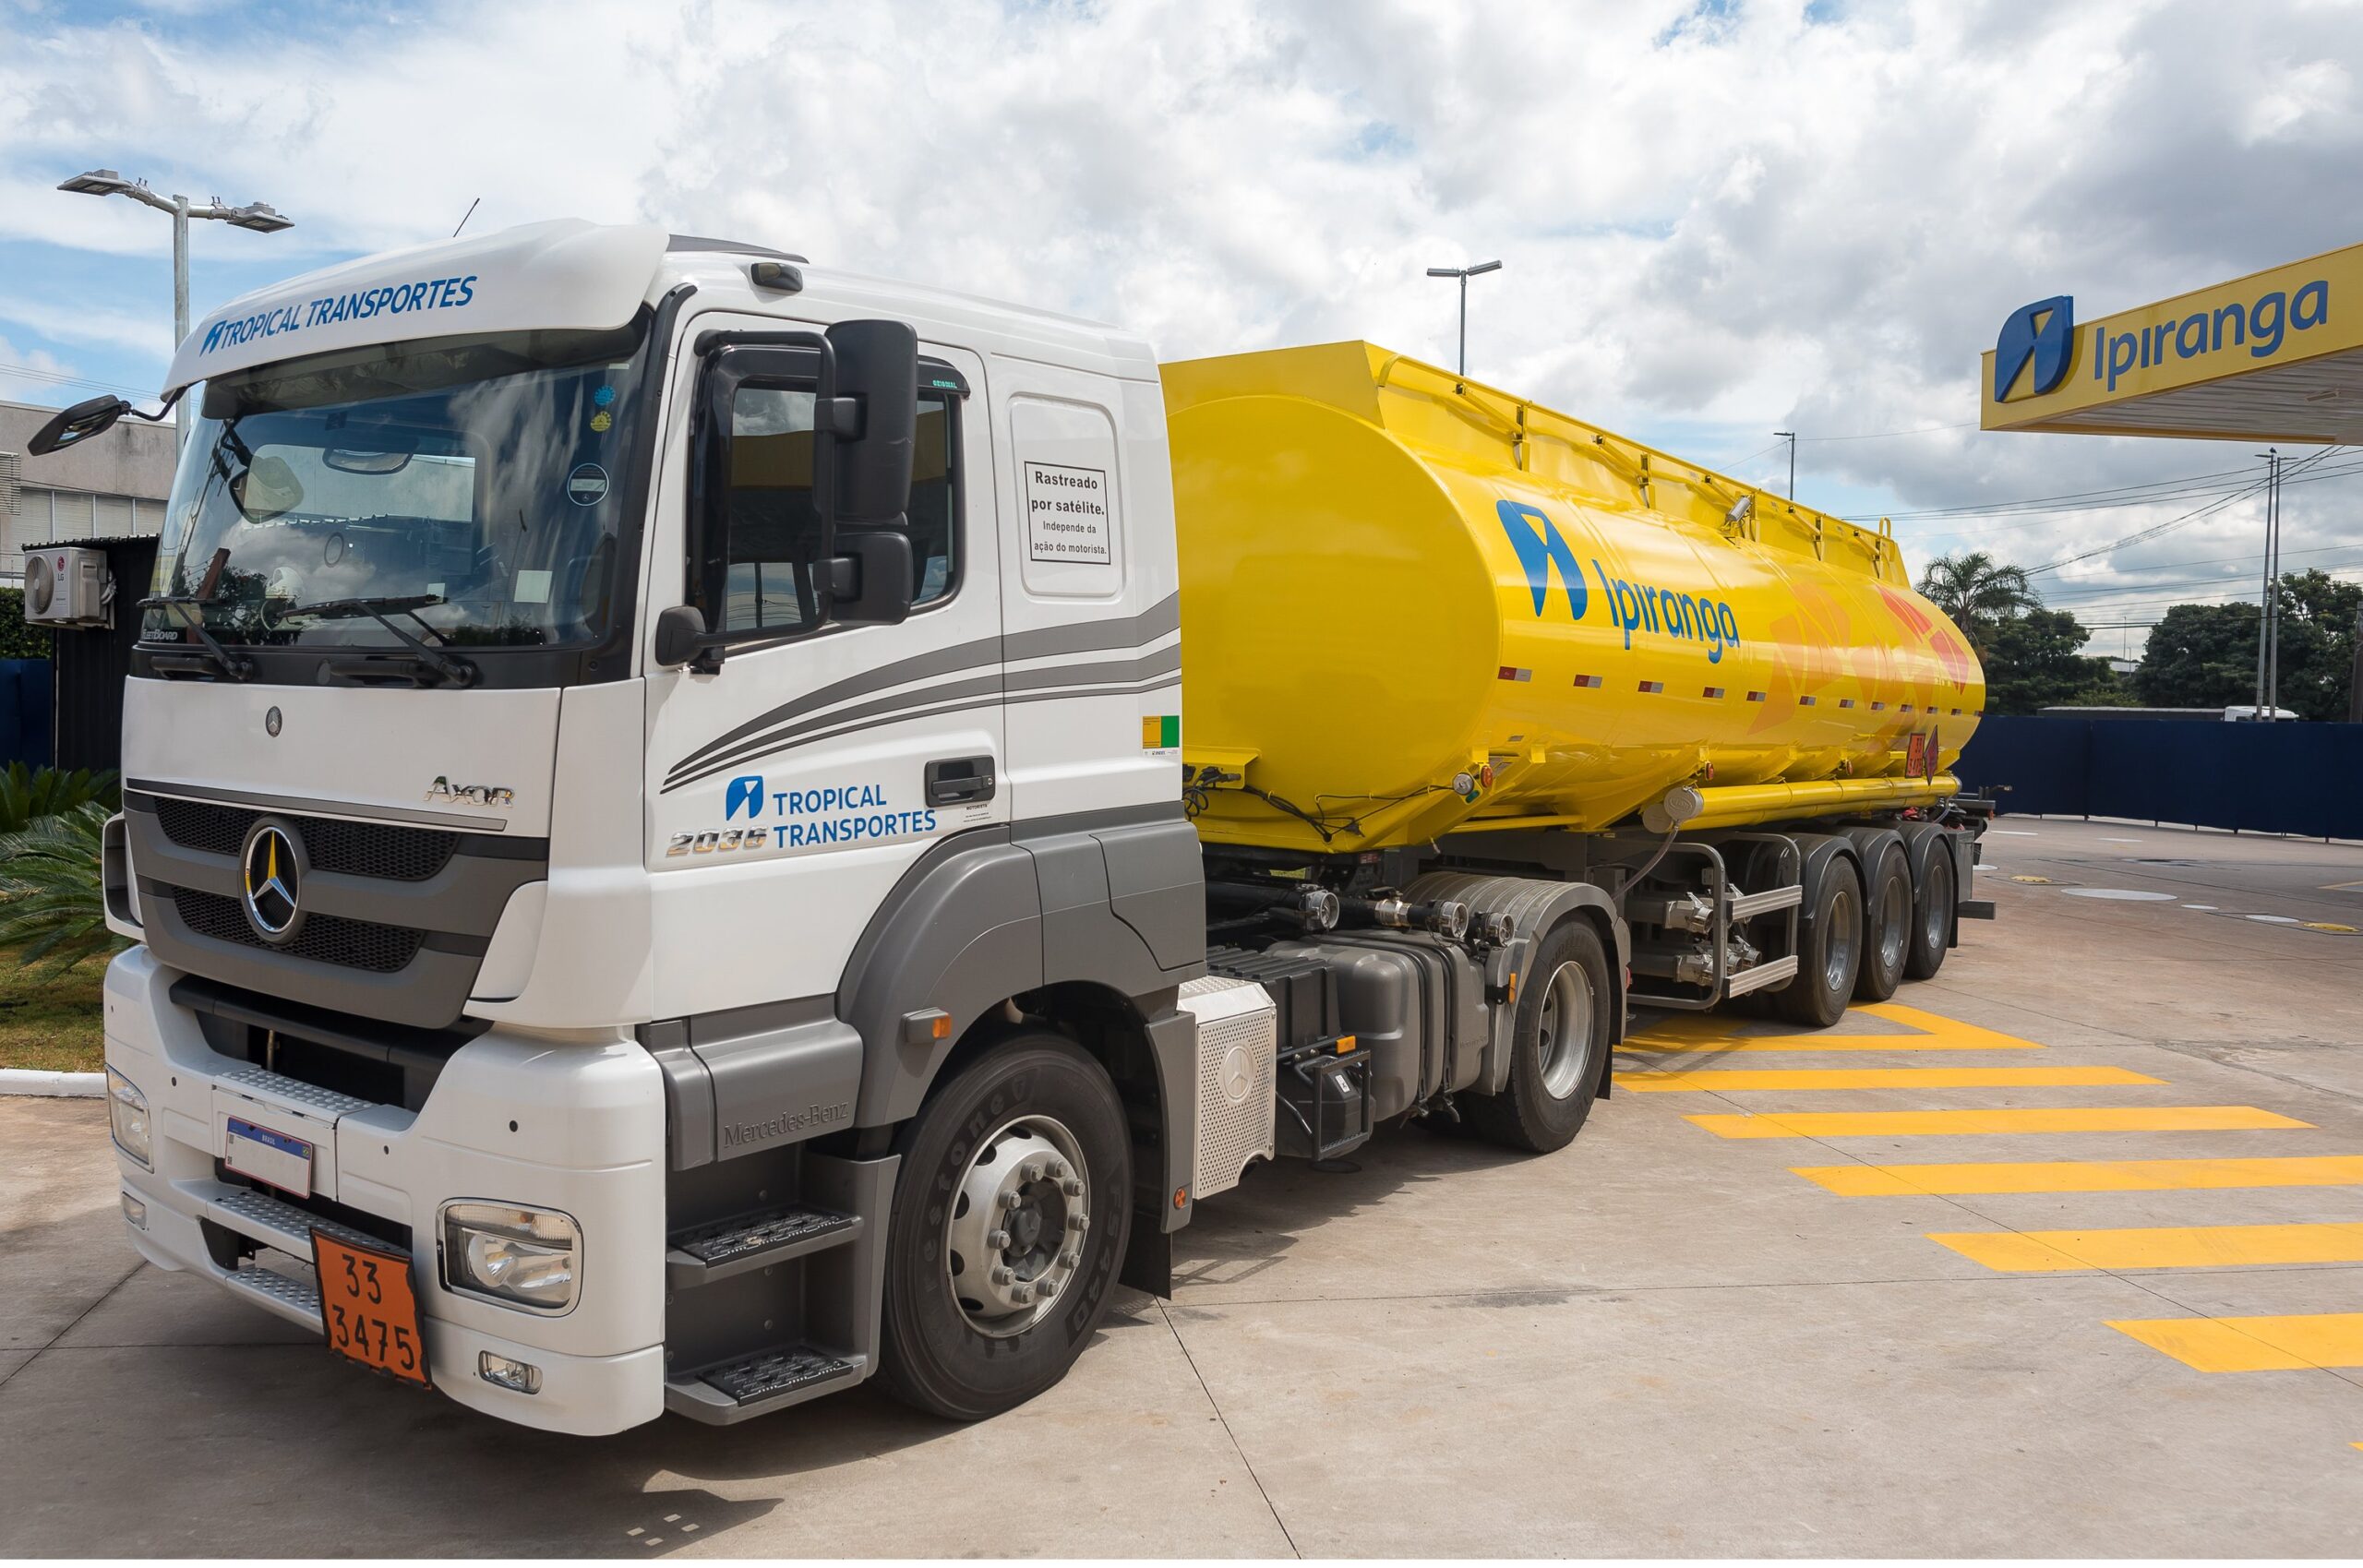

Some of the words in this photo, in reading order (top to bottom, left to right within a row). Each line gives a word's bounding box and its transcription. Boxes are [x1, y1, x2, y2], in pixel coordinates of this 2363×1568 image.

[221, 304, 303, 350] TROPICAL
[306, 275, 478, 328] TRANSPORTES
[2094, 280, 2329, 392] Ipiranga
[1035, 471, 1098, 490] Rastreado
[1031, 499, 1052, 512] por
[1056, 500, 1105, 515] satélite.
[1043, 521, 1085, 533] Independe
[1086, 524, 1097, 533] da
[1034, 542, 1054, 554] ação
[1056, 543, 1066, 552] do
[1068, 544, 1107, 555] motorista.
[57, 573, 65, 581] LG
[1592, 559, 1741, 664] Ipiranga
[773, 784, 887, 816] TROPICAL
[666, 826, 768, 857] 2036
[774, 809, 937, 849] TRANSPORTES
[261, 1133, 276, 1145] BRASIL
[724, 1102, 849, 1149] Mercedes-Benz
[342, 1253, 382, 1305] 33
[331, 1304, 414, 1371] 3475
